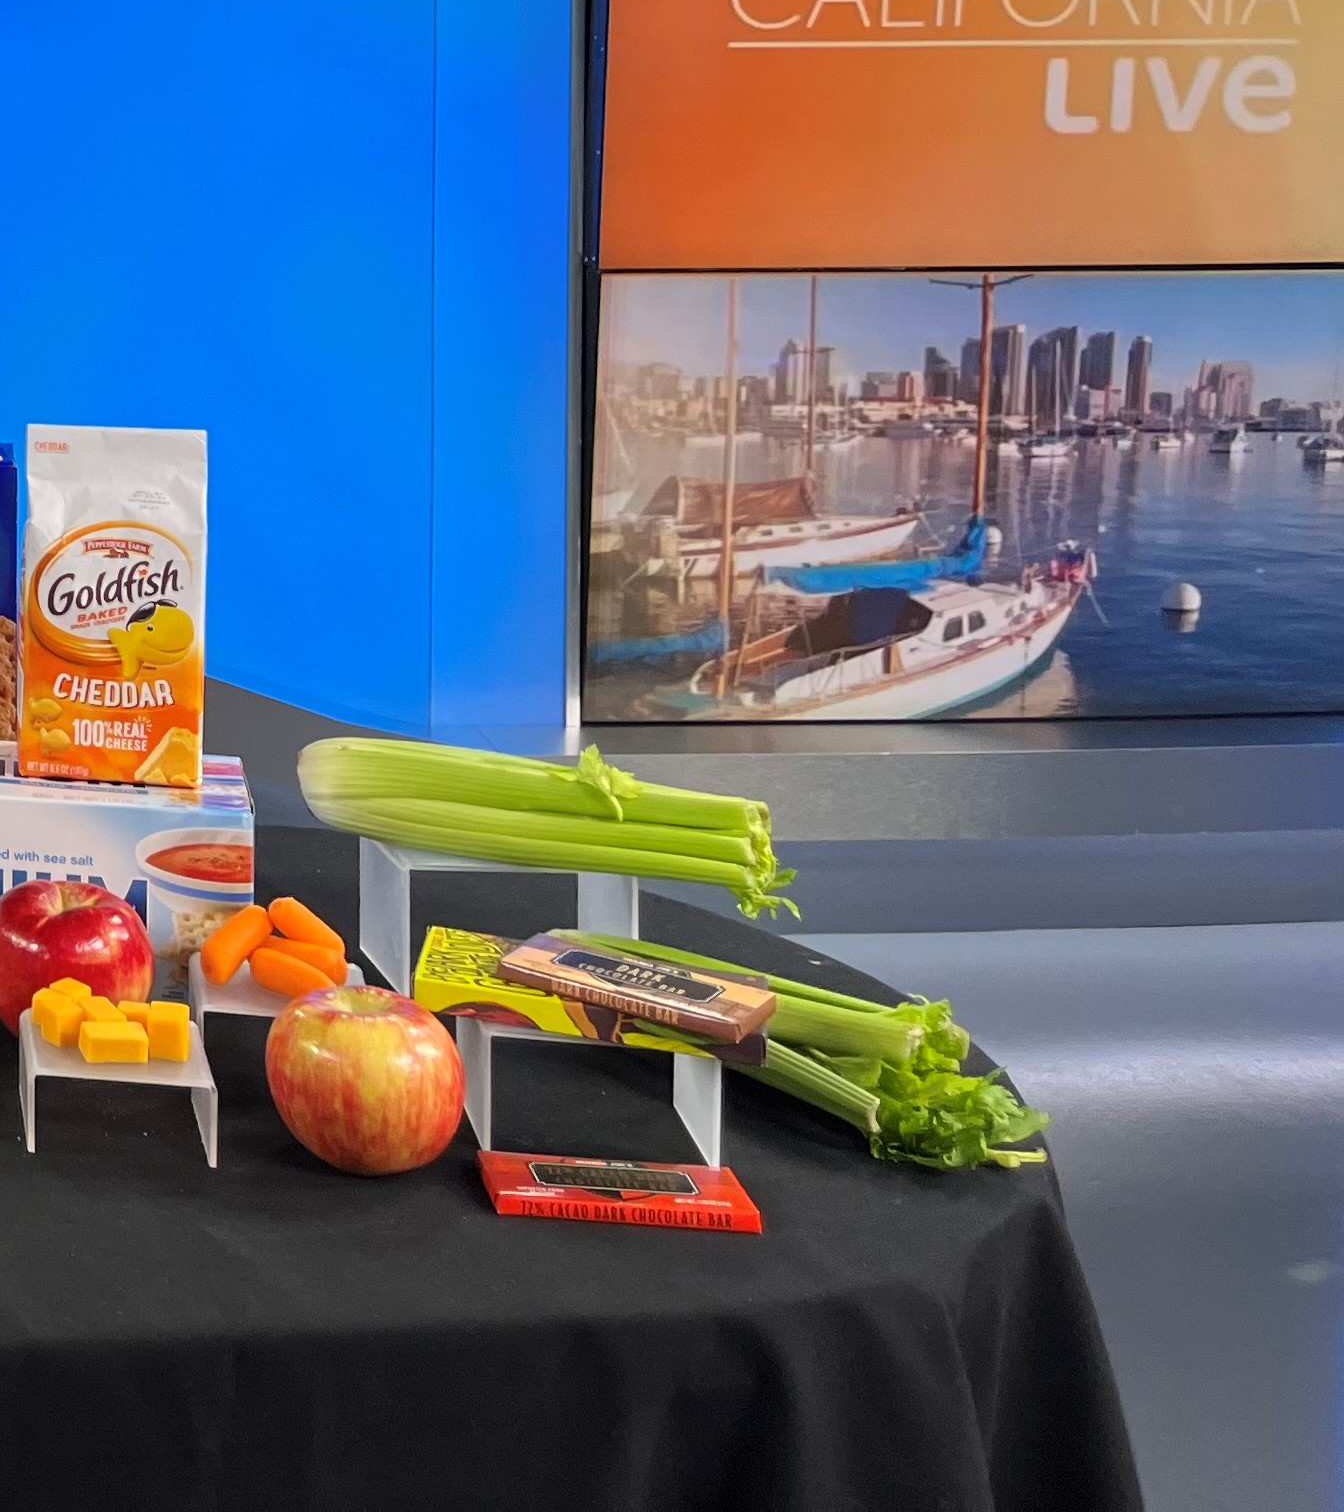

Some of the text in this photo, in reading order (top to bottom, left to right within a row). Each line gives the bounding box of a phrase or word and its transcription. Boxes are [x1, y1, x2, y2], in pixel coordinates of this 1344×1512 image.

[47, 559, 179, 617] Goldfish
[77, 606, 128, 623] BAKED
[52, 672, 175, 709] CHEDDAR
[113, 721, 148, 739] REAL
[105, 737, 148, 752] CHEESE
[13, 848, 40, 863] with
[43, 853, 67, 865] sea
[70, 854, 94, 866] salt
[615, 963, 667, 983] DARK
[520, 1200, 733, 1229] 72% CACAO DARK CHOCOLATE BAR
